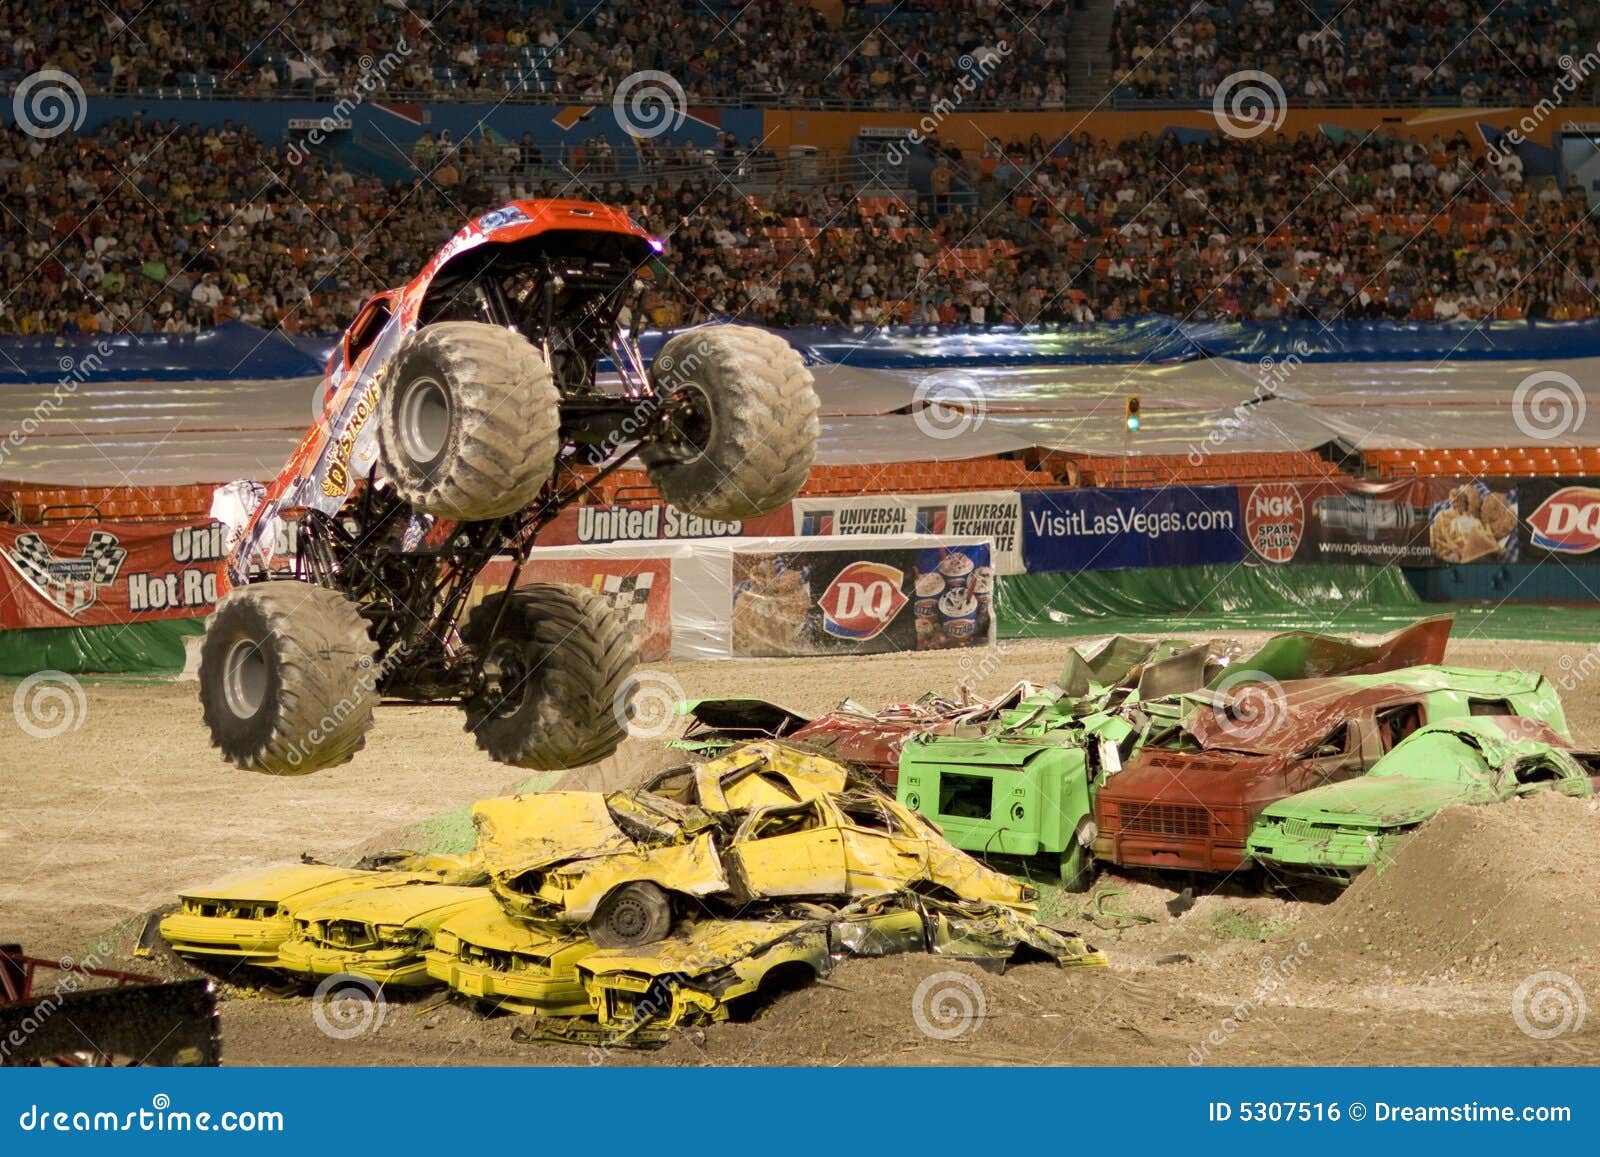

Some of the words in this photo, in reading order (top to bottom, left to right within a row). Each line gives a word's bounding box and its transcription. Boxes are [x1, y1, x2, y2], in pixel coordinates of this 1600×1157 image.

[839, 507, 907, 525] UNIVERSAL
[953, 504, 1018, 520] UNIVERSAL
[1256, 496, 1294, 517] NGK
[579, 505, 659, 541] United
[952, 520, 1016, 536] TECHNICAL
[1030, 506, 1233, 538] VisitLasVegas.com
[1259, 536, 1298, 549] PLUGS
[128, 572, 180, 611] Hot
[834, 582, 893, 622] DQ
